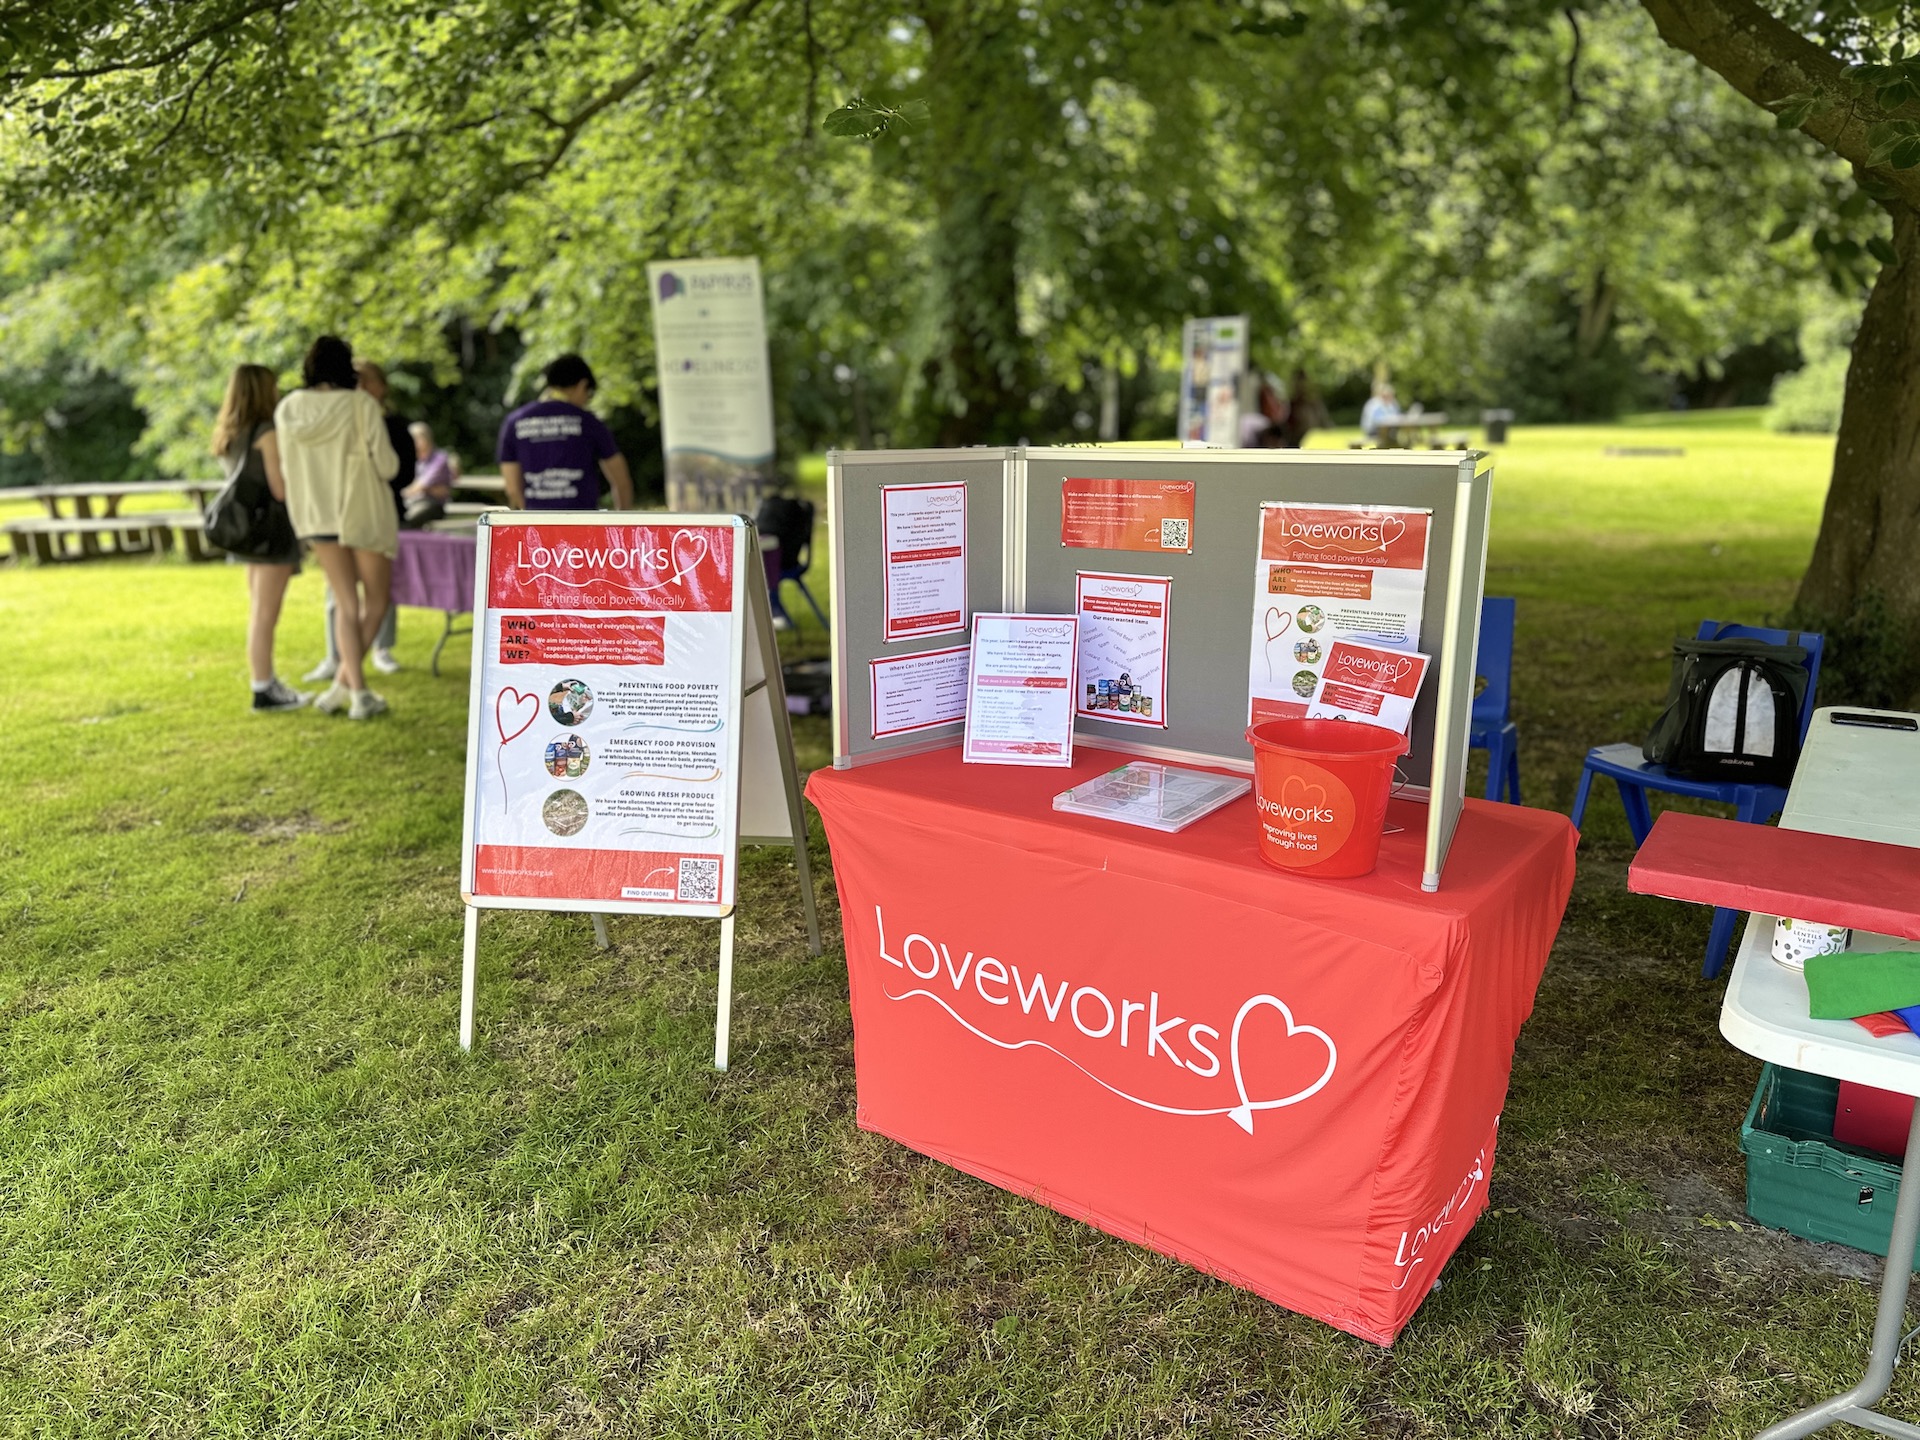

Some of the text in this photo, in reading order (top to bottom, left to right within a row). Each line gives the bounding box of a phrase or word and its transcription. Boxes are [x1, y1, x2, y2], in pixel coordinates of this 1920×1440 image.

[1281, 520, 1378, 541] Loveworks
[517, 541, 669, 570] Loveworks
[1292, 550, 1318, 560] Fighting
[1337, 553, 1364, 562] poverty
[1365, 554, 1388, 564] locally
[1101, 584, 1133, 594] Loveworks
[538, 593, 686, 609] Fighting food poverty locally
[507, 621, 536, 630] WHO
[603, 623, 634, 631] everything
[1025, 626, 1062, 634] Loveworks
[1108, 626, 1133, 642] Corned Beef
[507, 635, 528, 644] ARE
[1113, 644, 1127, 654] Cereal
[1141, 648, 1161, 656] Tomatoes
[506, 650, 530, 659] WE?
[1085, 651, 1100, 660] Custard
[1114, 661, 1131, 672] Pudding
[1338, 651, 1395, 674] Loveworks
[1137, 671, 1150, 681] Tinned
[1341, 675, 1356, 684] Fighting
[1267, 833, 1294, 849] through
[1298, 832, 1317, 840] lives
[482, 868, 553, 877] www.loveworks.org.uk
[1794, 931, 1822, 940] LENTILS
[875, 904, 1221, 1078] Loveworks
